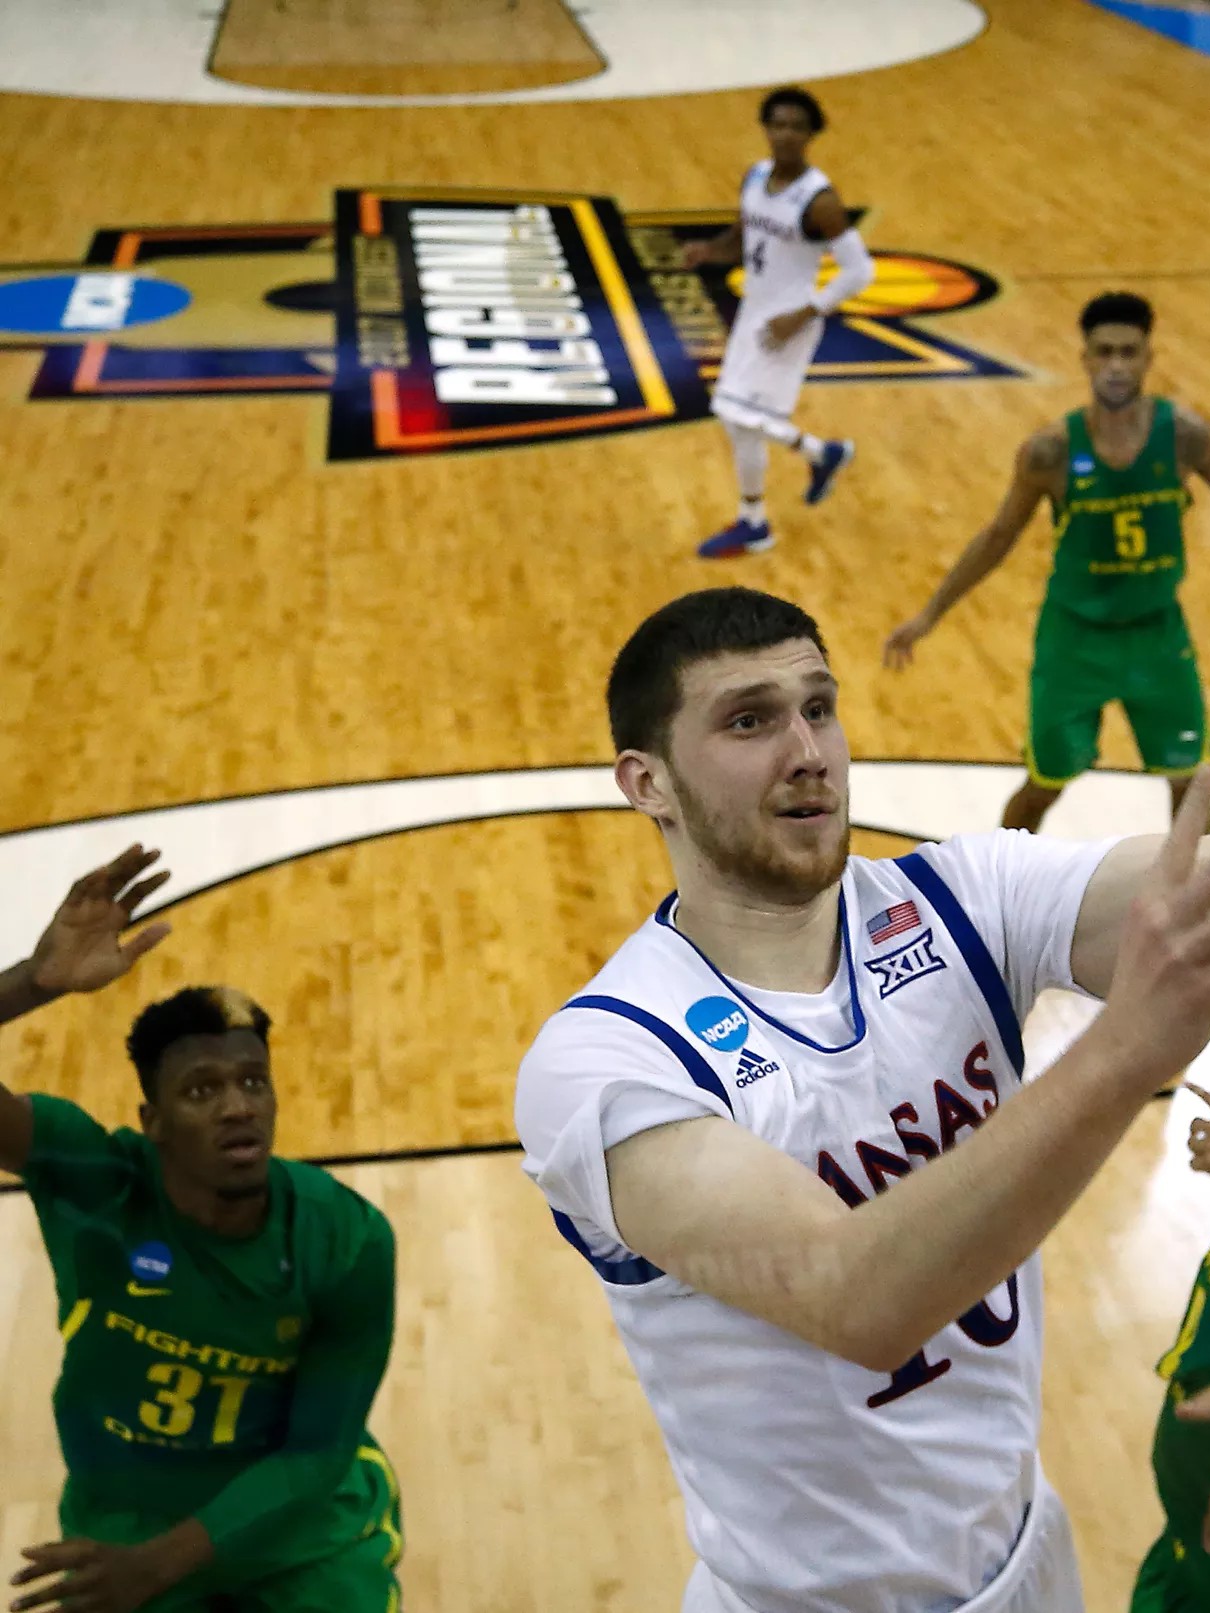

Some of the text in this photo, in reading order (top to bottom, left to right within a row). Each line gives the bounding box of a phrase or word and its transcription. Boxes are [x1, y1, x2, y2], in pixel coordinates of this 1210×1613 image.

[408, 203, 619, 405] REGIONAL
[1113, 510, 1147, 559] 5
[700, 1010, 748, 1045] NCAA
[735, 1061, 781, 1089] adidas
[137, 1362, 252, 1445] 31
